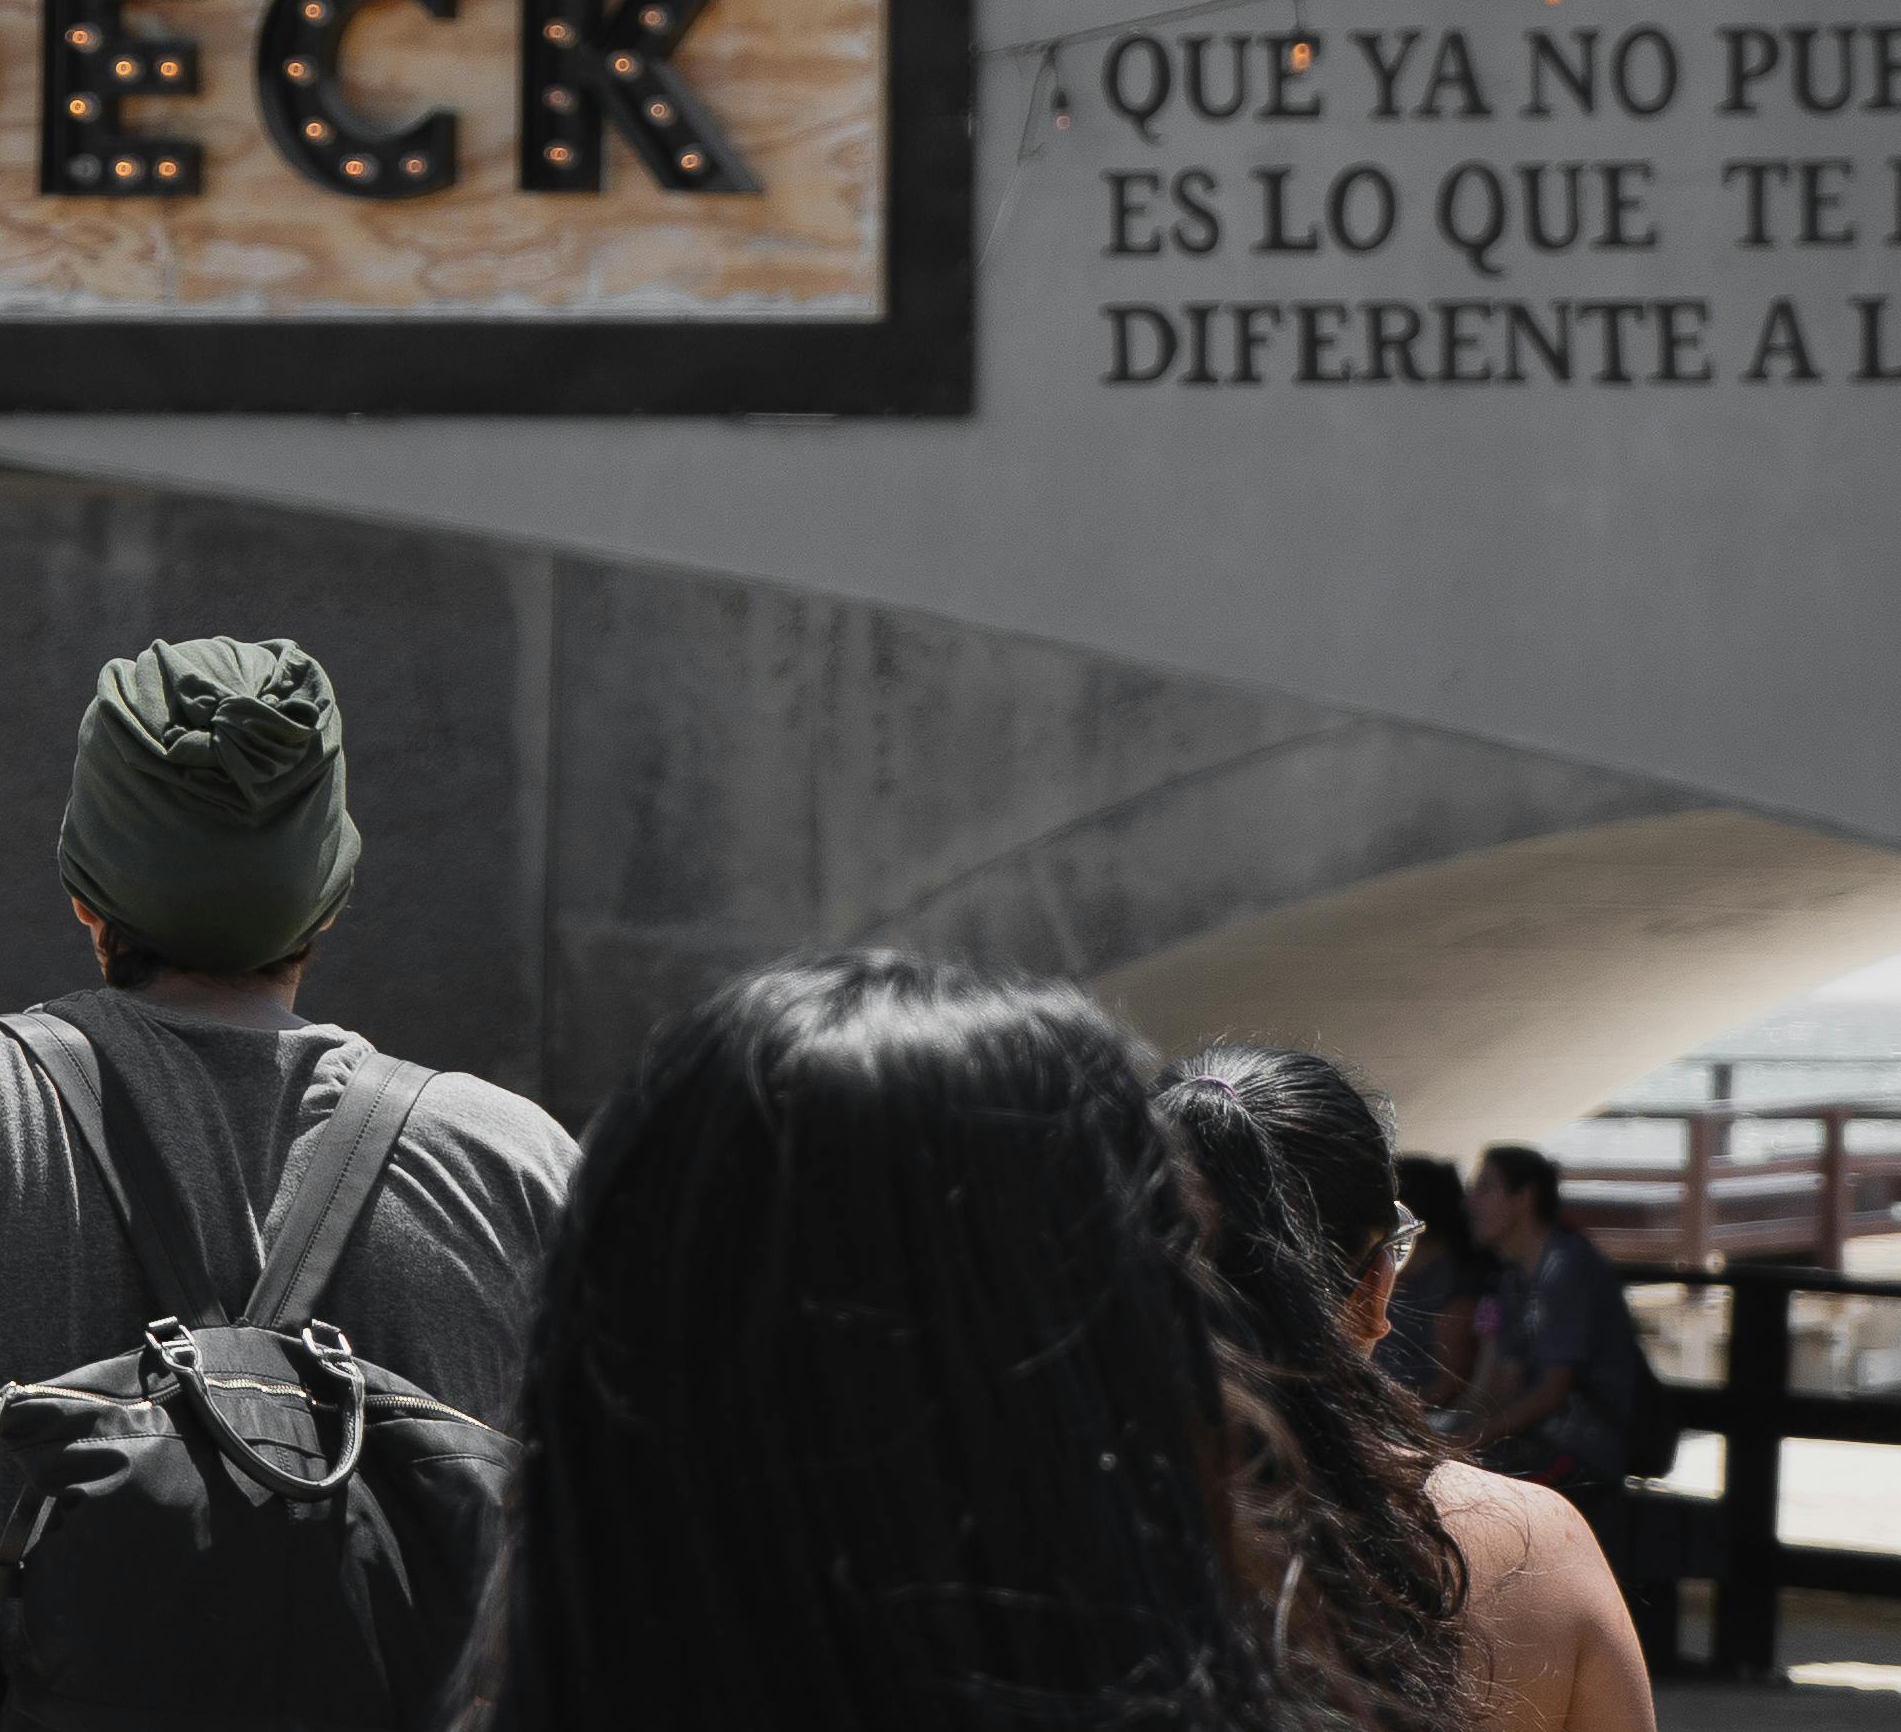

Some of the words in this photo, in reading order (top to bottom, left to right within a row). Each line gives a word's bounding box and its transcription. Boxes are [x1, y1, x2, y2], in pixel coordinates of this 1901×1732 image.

[1103, 29, 1322, 144] QUE
[1350, 29, 1490, 117] YA
[1520, 27, 1678, 117] NO
[1103, 165, 1220, 257] ES
[1250, 161, 1396, 254] LO
[1434, 159, 1656, 276] QUE
[1722, 157, 1856, 249] TE
[1103, 299, 1712, 385] DIFERENTE
[1744, 295, 1822, 383] A
